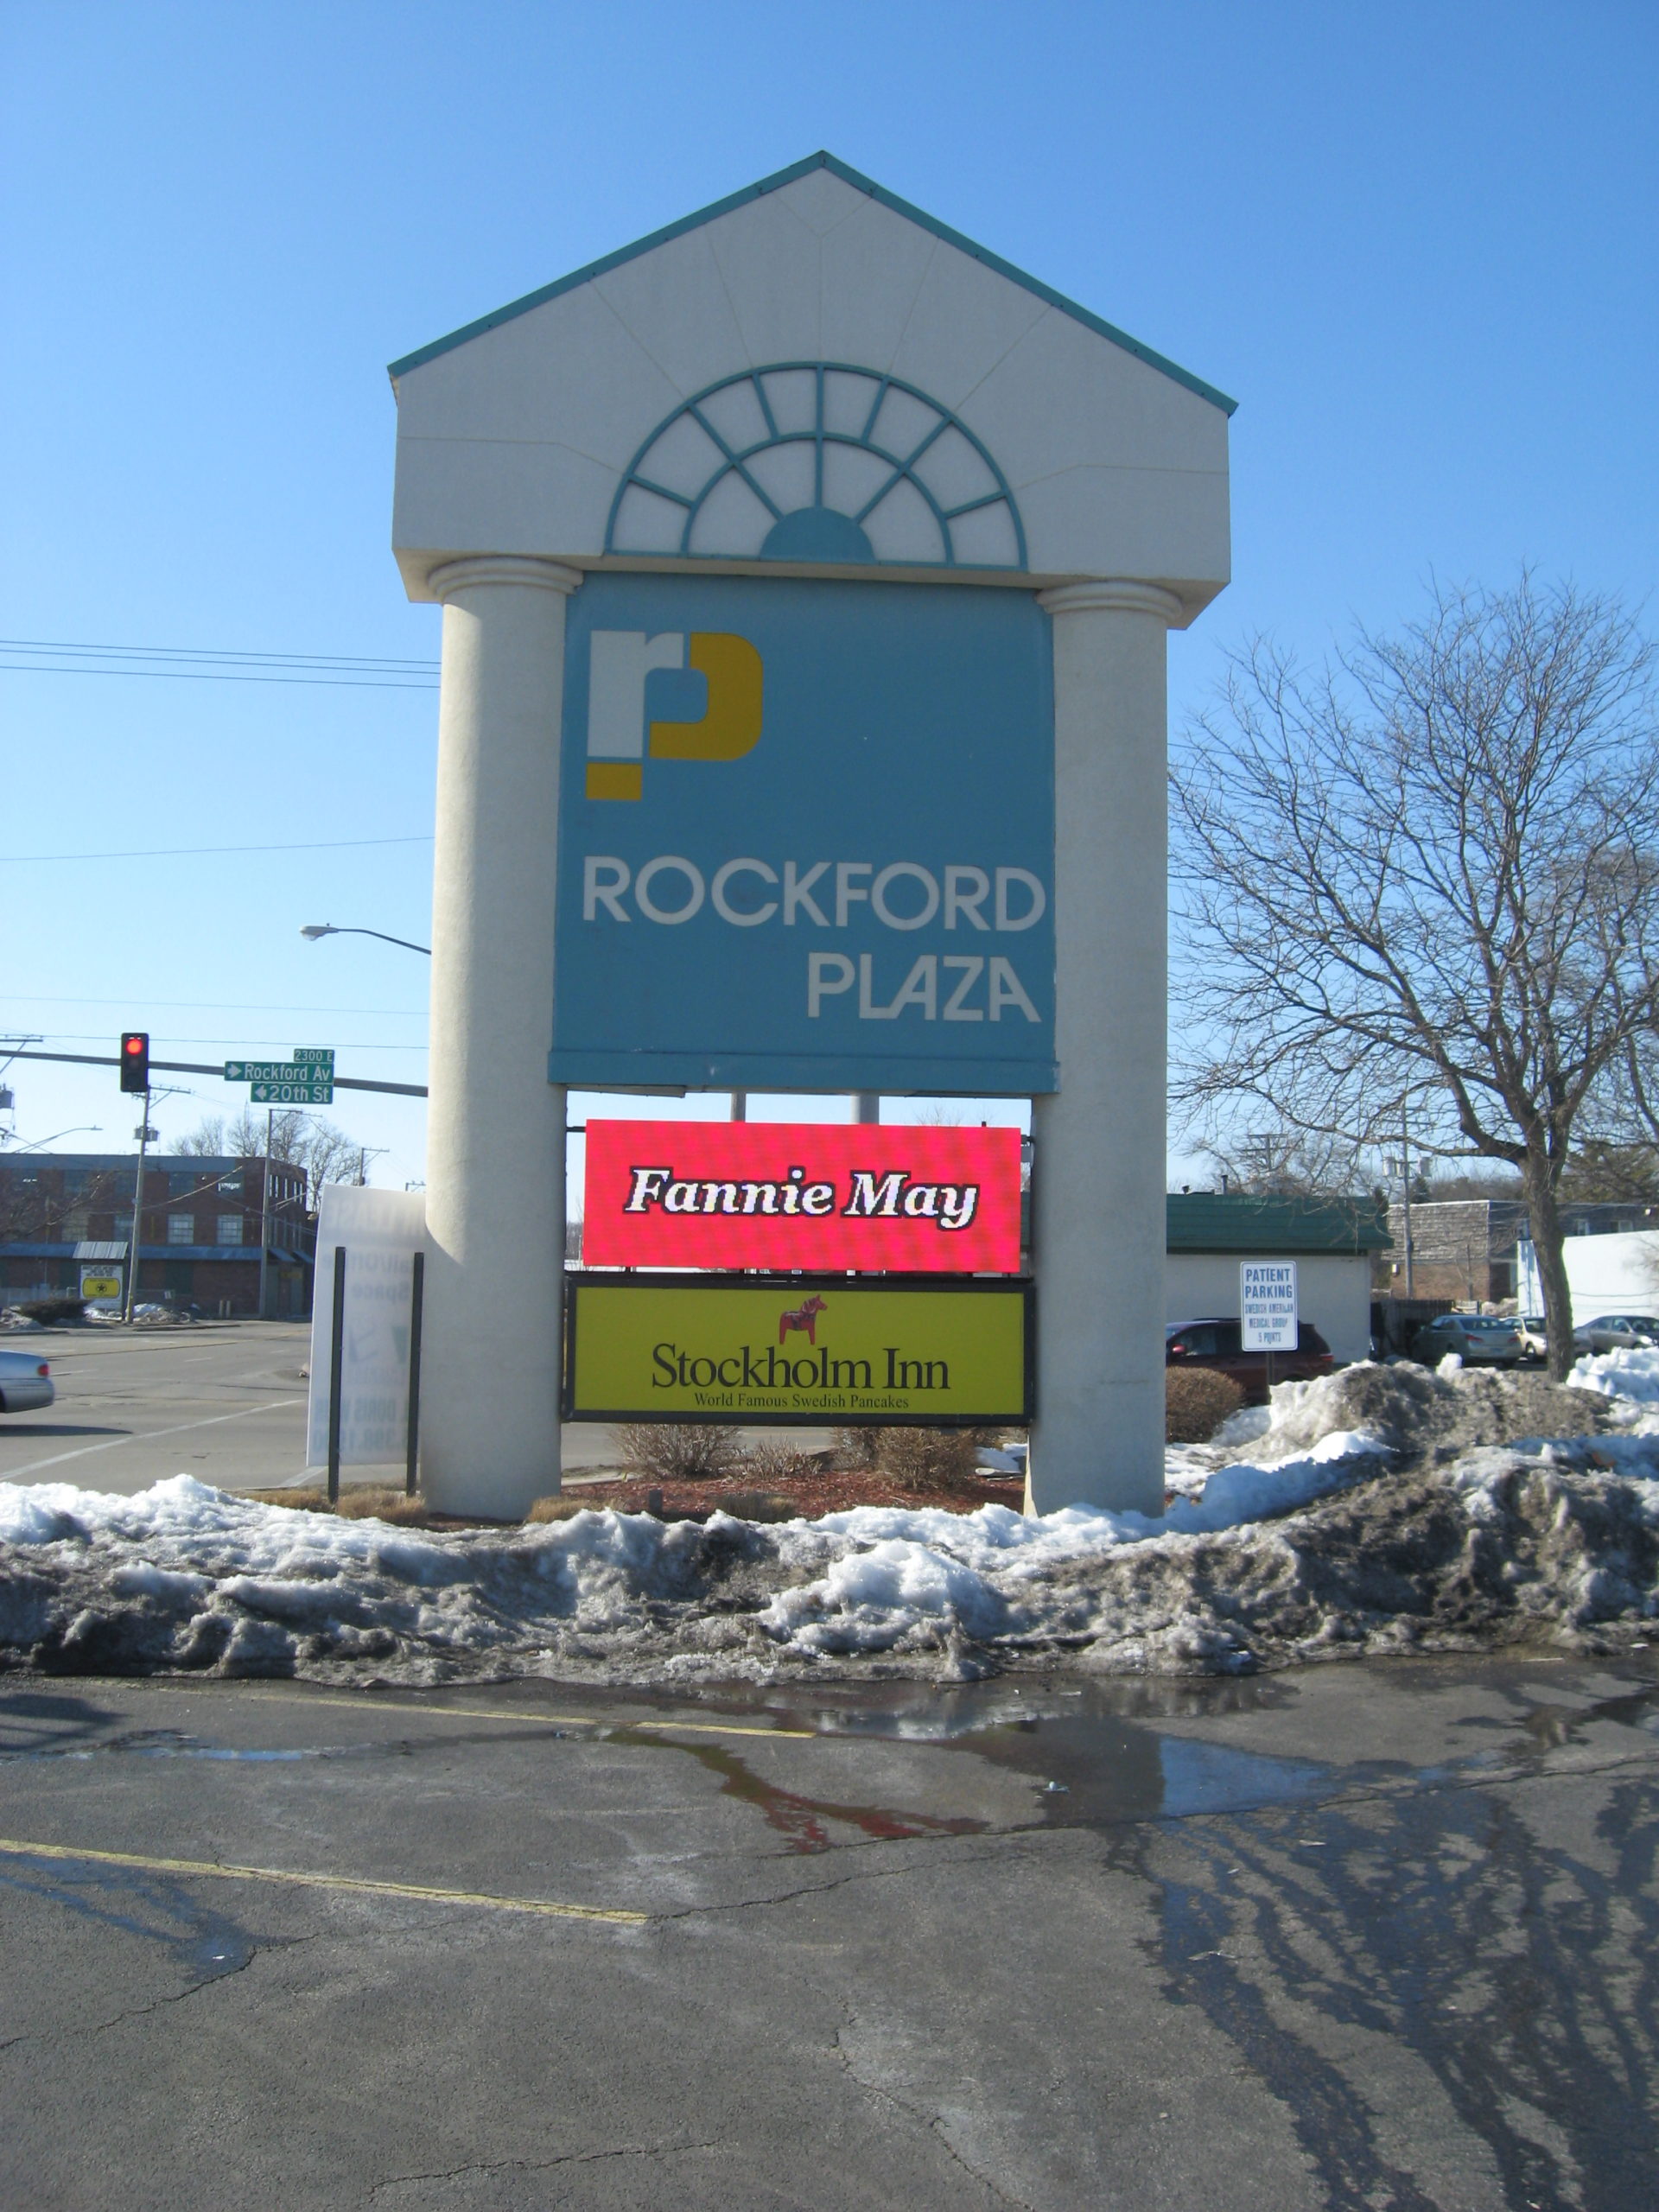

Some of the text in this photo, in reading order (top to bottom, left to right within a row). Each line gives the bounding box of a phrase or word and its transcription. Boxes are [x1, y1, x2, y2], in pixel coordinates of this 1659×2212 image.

[582, 855, 1046, 931] ROCKFORD
[807, 952, 1042, 1023] PLAZA
[294, 1050, 333, 1062] 2300 E
[245, 1064, 329, 1082] Rockford Av
[269, 1085, 328, 1103] 20th St
[622, 1166, 980, 1232] Fannie May
[1246, 1268, 1290, 1282] PATIENT
[1245, 1285, 1293, 1299] PARKING
[1249, 1318, 1270, 1328] MEDICAL
[652, 1343, 951, 1389] Stockholm Inn
[694, 1393, 909, 1408] World Famous Swedish Pancakes
